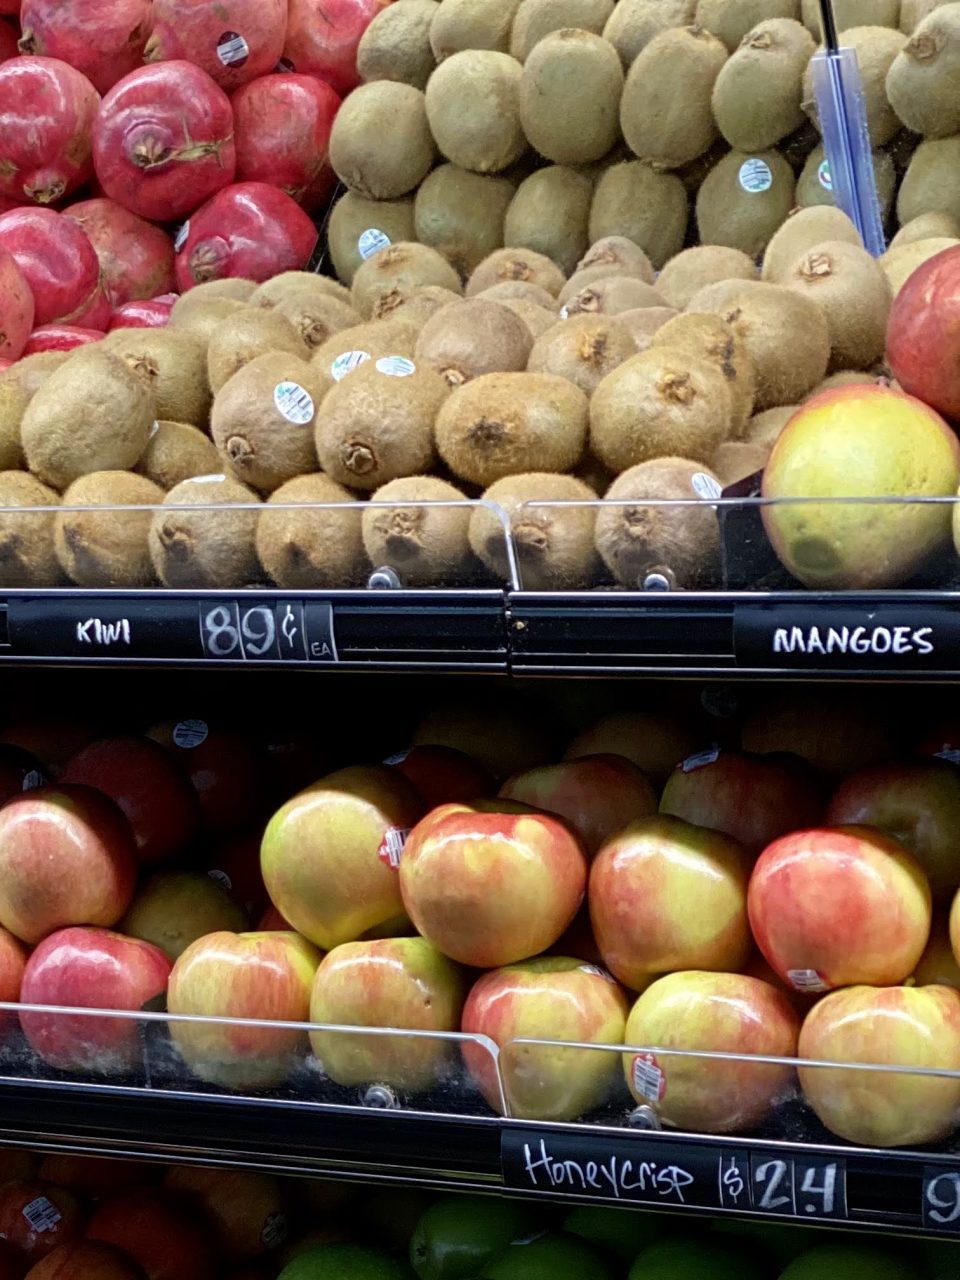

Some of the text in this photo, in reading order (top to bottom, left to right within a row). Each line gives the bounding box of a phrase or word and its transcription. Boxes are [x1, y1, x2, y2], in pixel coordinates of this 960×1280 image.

[77, 618, 131, 645] KIWI
[310, 641, 331, 657] EA
[773, 626, 934, 654] MANGOES
[524, 1139, 694, 1202] Honeycrisp
